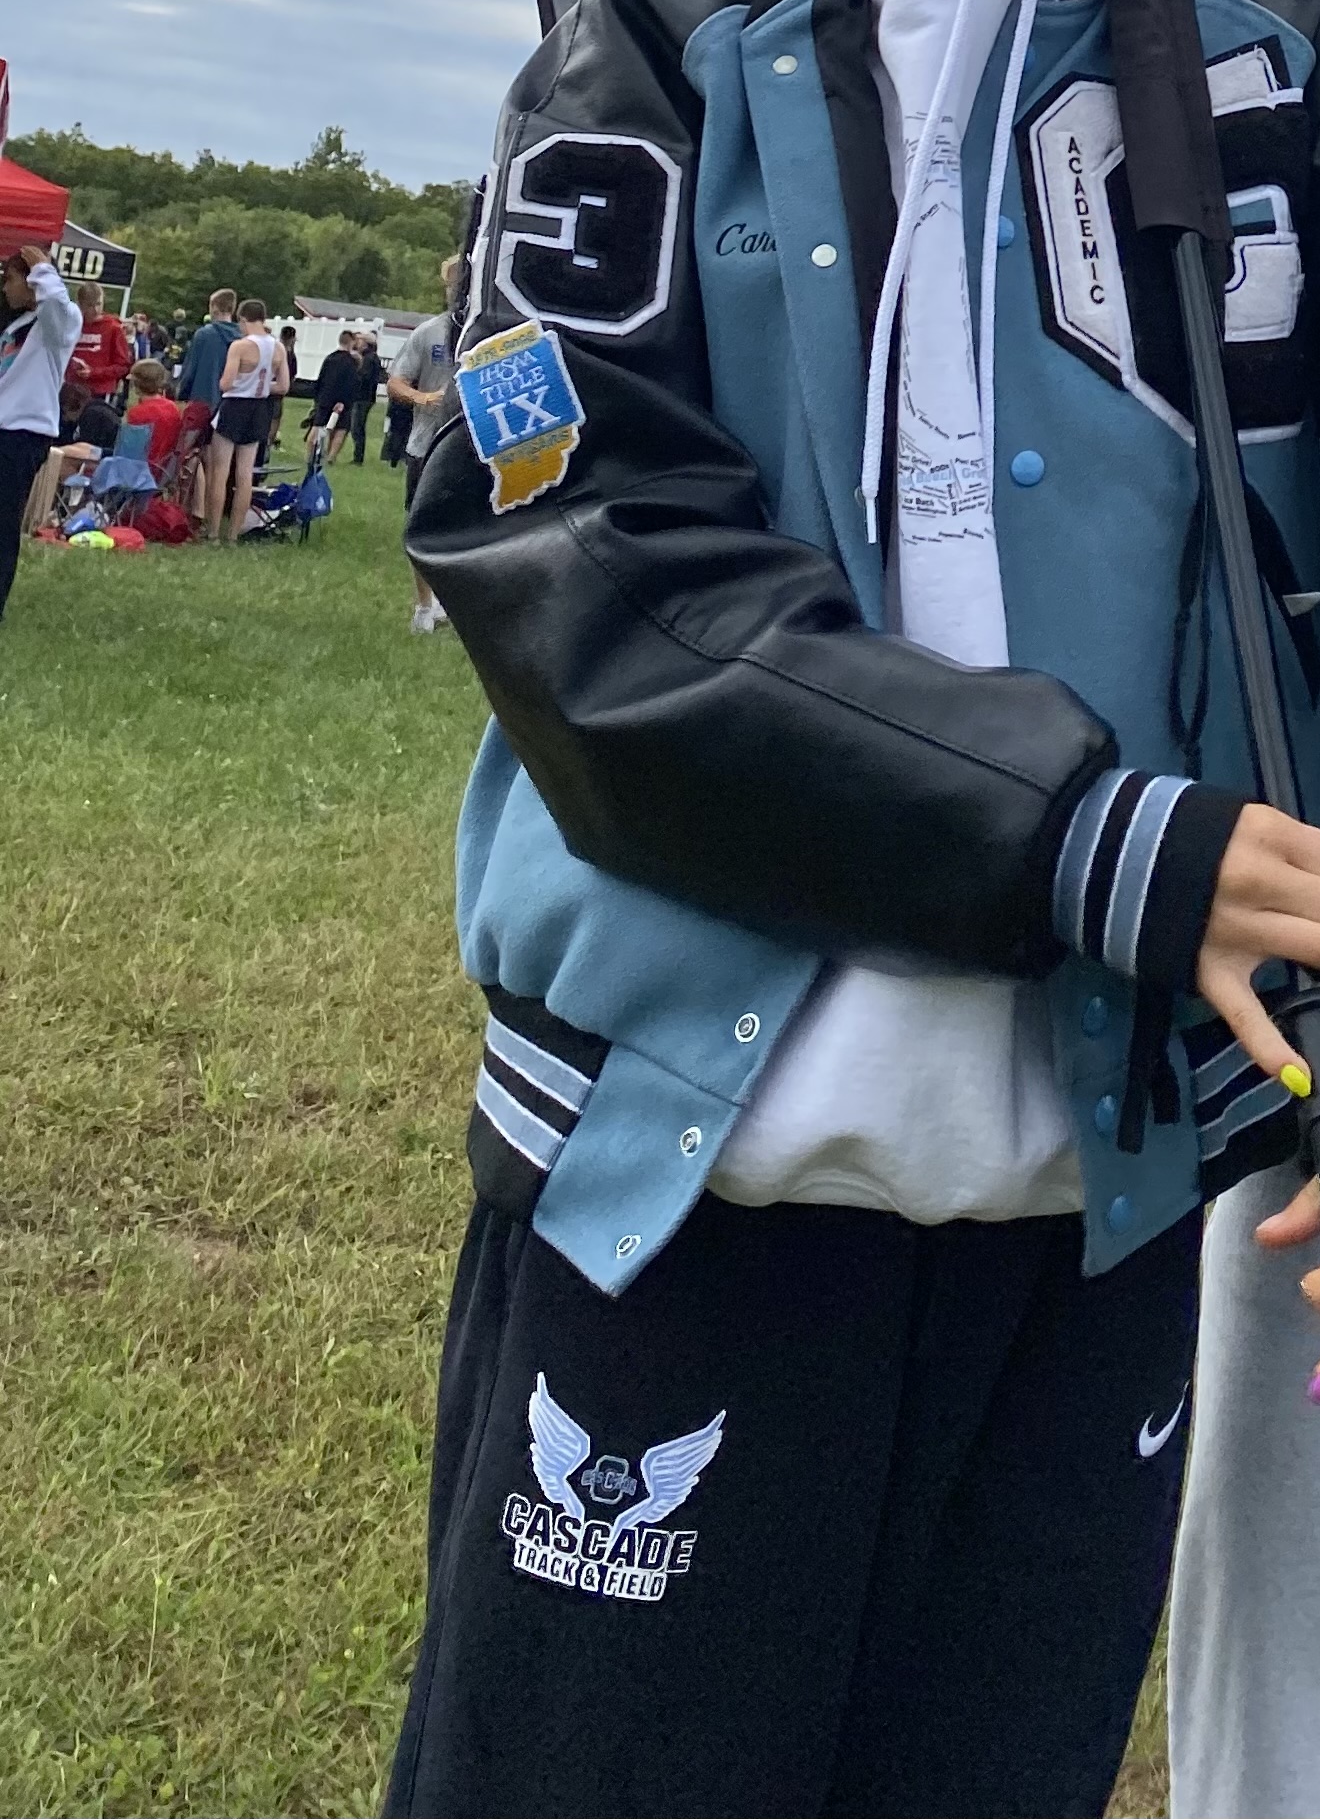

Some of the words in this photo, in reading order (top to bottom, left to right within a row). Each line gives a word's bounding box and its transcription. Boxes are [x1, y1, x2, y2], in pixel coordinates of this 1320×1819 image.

[1067, 135, 1105, 305] ACADEMIC
[480, 365, 545, 404] TITLE
[486, 385, 561, 446] IX
[502, 1492, 698, 1574] CASCADE
[514, 1541, 577, 1585] TRACK
[582, 1562, 600, 1591] &
[605, 1568, 667, 1599] FIELD
